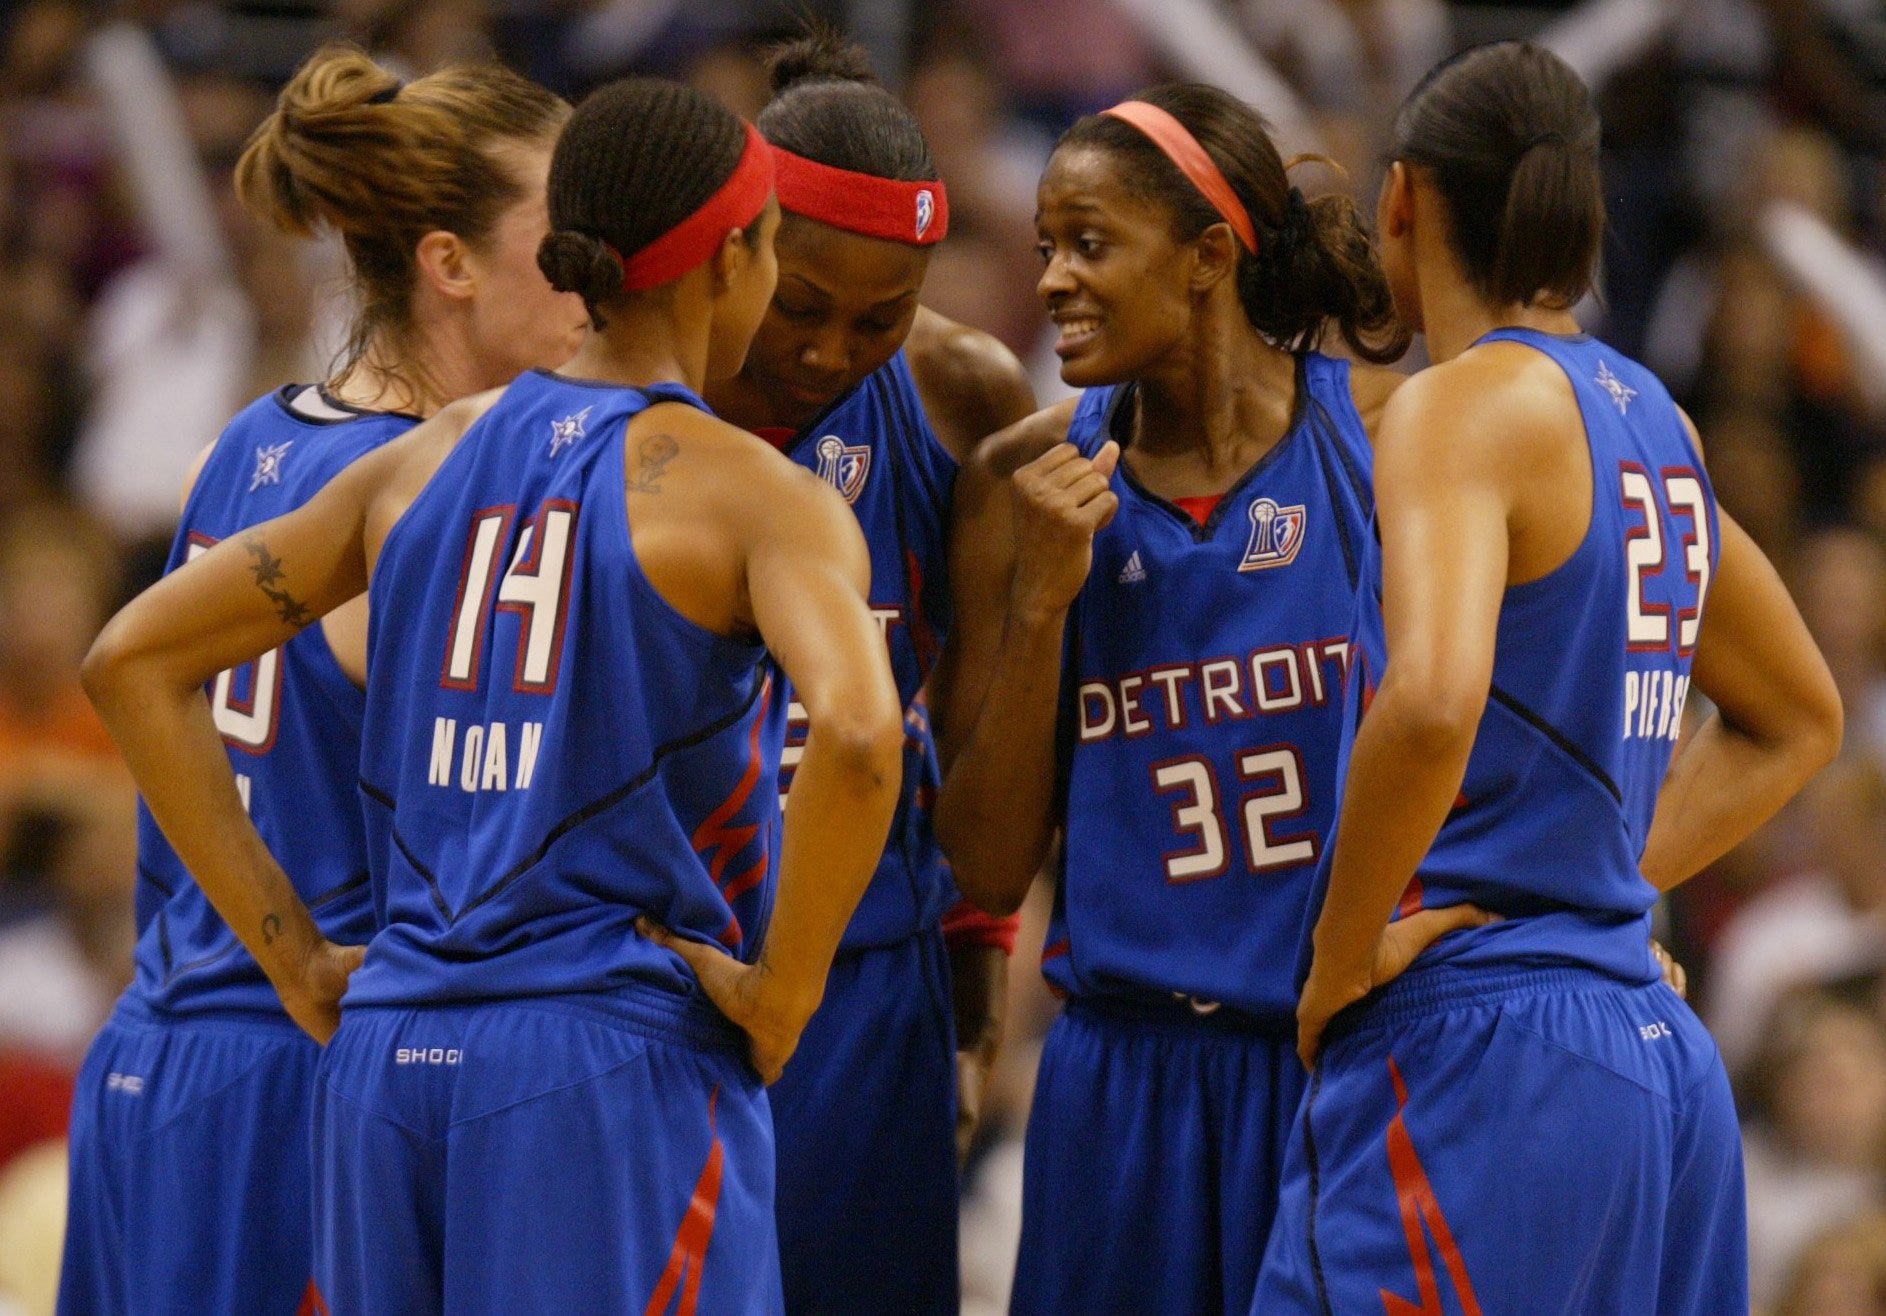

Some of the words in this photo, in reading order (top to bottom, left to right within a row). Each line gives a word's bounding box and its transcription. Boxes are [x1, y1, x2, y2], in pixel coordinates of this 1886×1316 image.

[441, 499, 578, 694] 14
[1619, 461, 1711, 657] 23
[1624, 670, 1690, 740] PIERS
[1152, 744, 1319, 883] 32
[396, 1048, 464, 1065] SHOC
